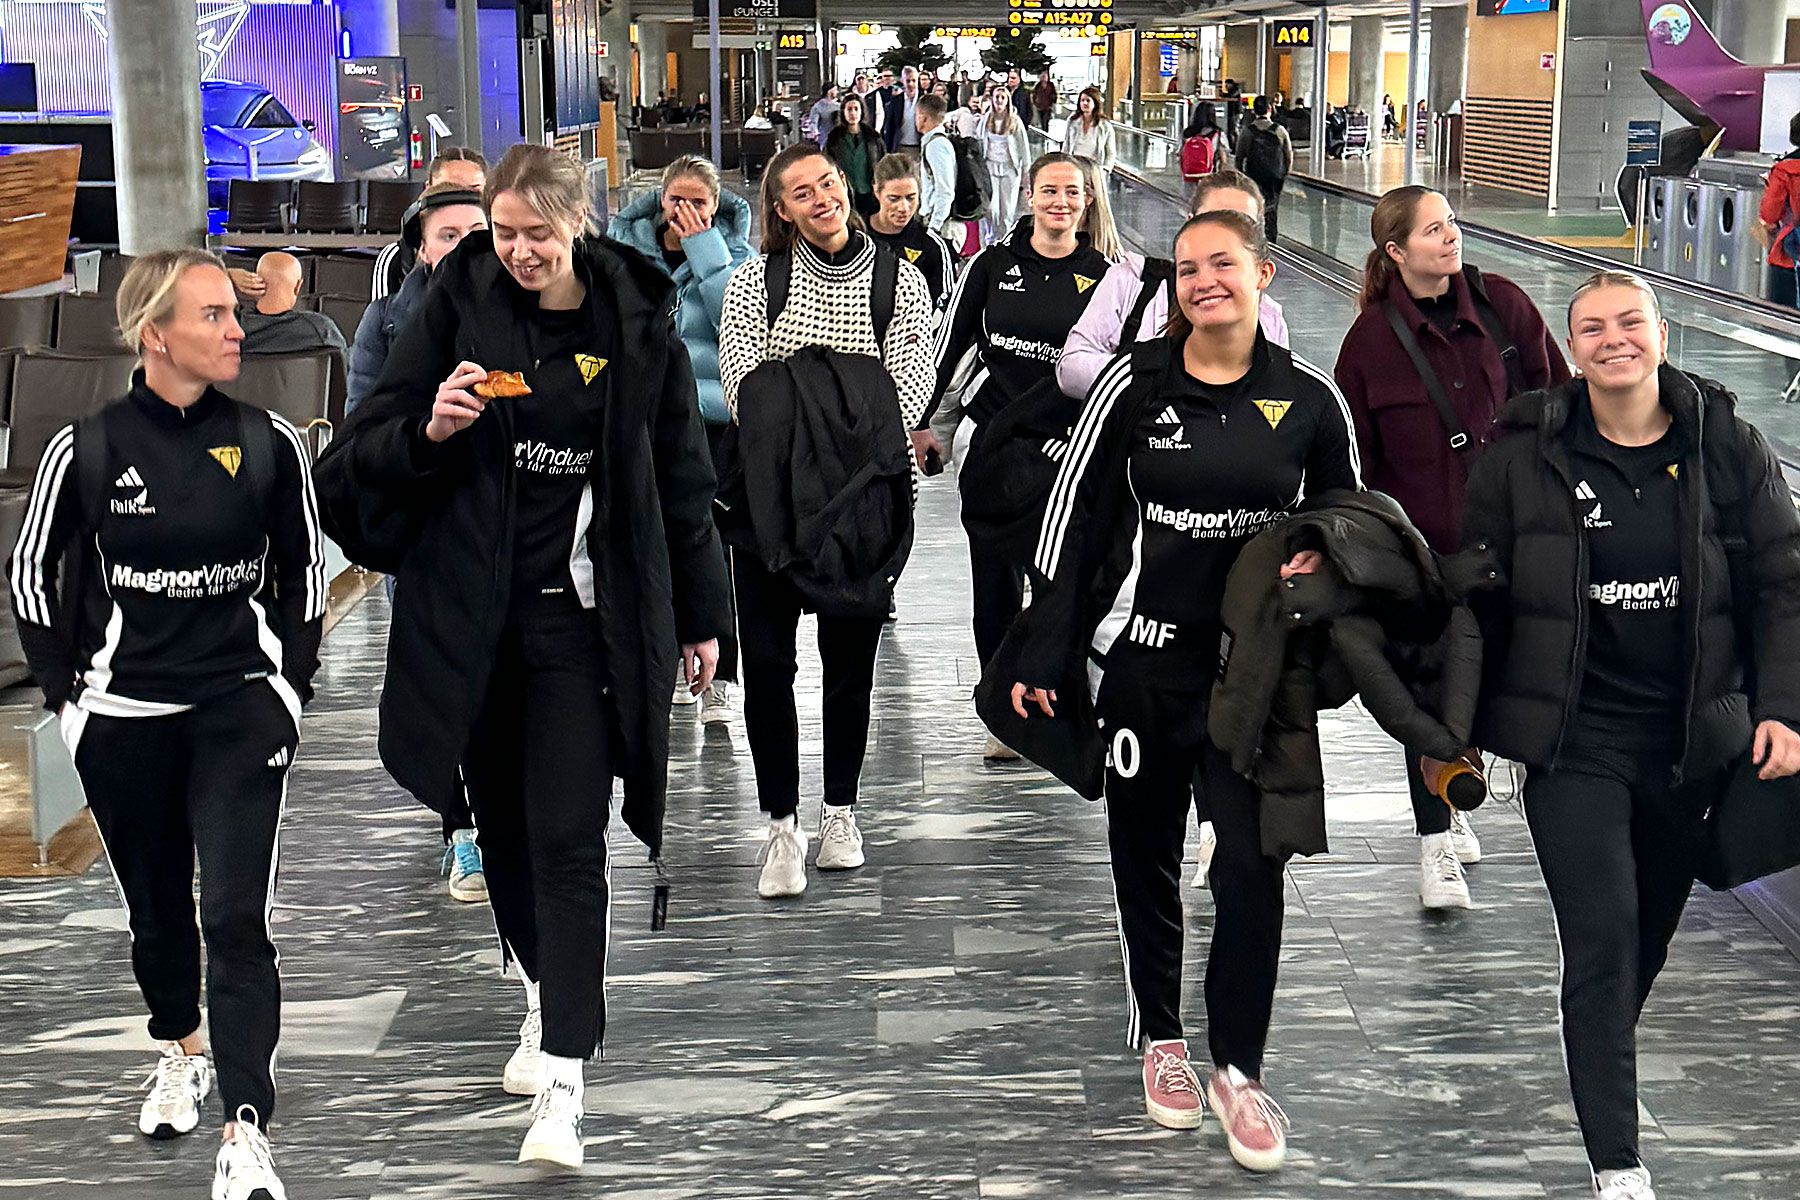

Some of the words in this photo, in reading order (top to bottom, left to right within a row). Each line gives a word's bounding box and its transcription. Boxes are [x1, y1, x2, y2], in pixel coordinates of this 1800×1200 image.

[734, 8, 773, 16] LOUNGE
[1044, 12, 1093, 24] A15-A27
[780, 34, 804, 48] A15
[1277, 26, 1309, 43] A14
[514, 440, 593, 466] rVindue
[1148, 436, 1174, 449] Falk
[1146, 501, 1289, 532] MagnorVindue
[1589, 576, 1679, 604] agnorVi
[1129, 614, 1177, 648] MF
[1105, 728, 1140, 778] 0
